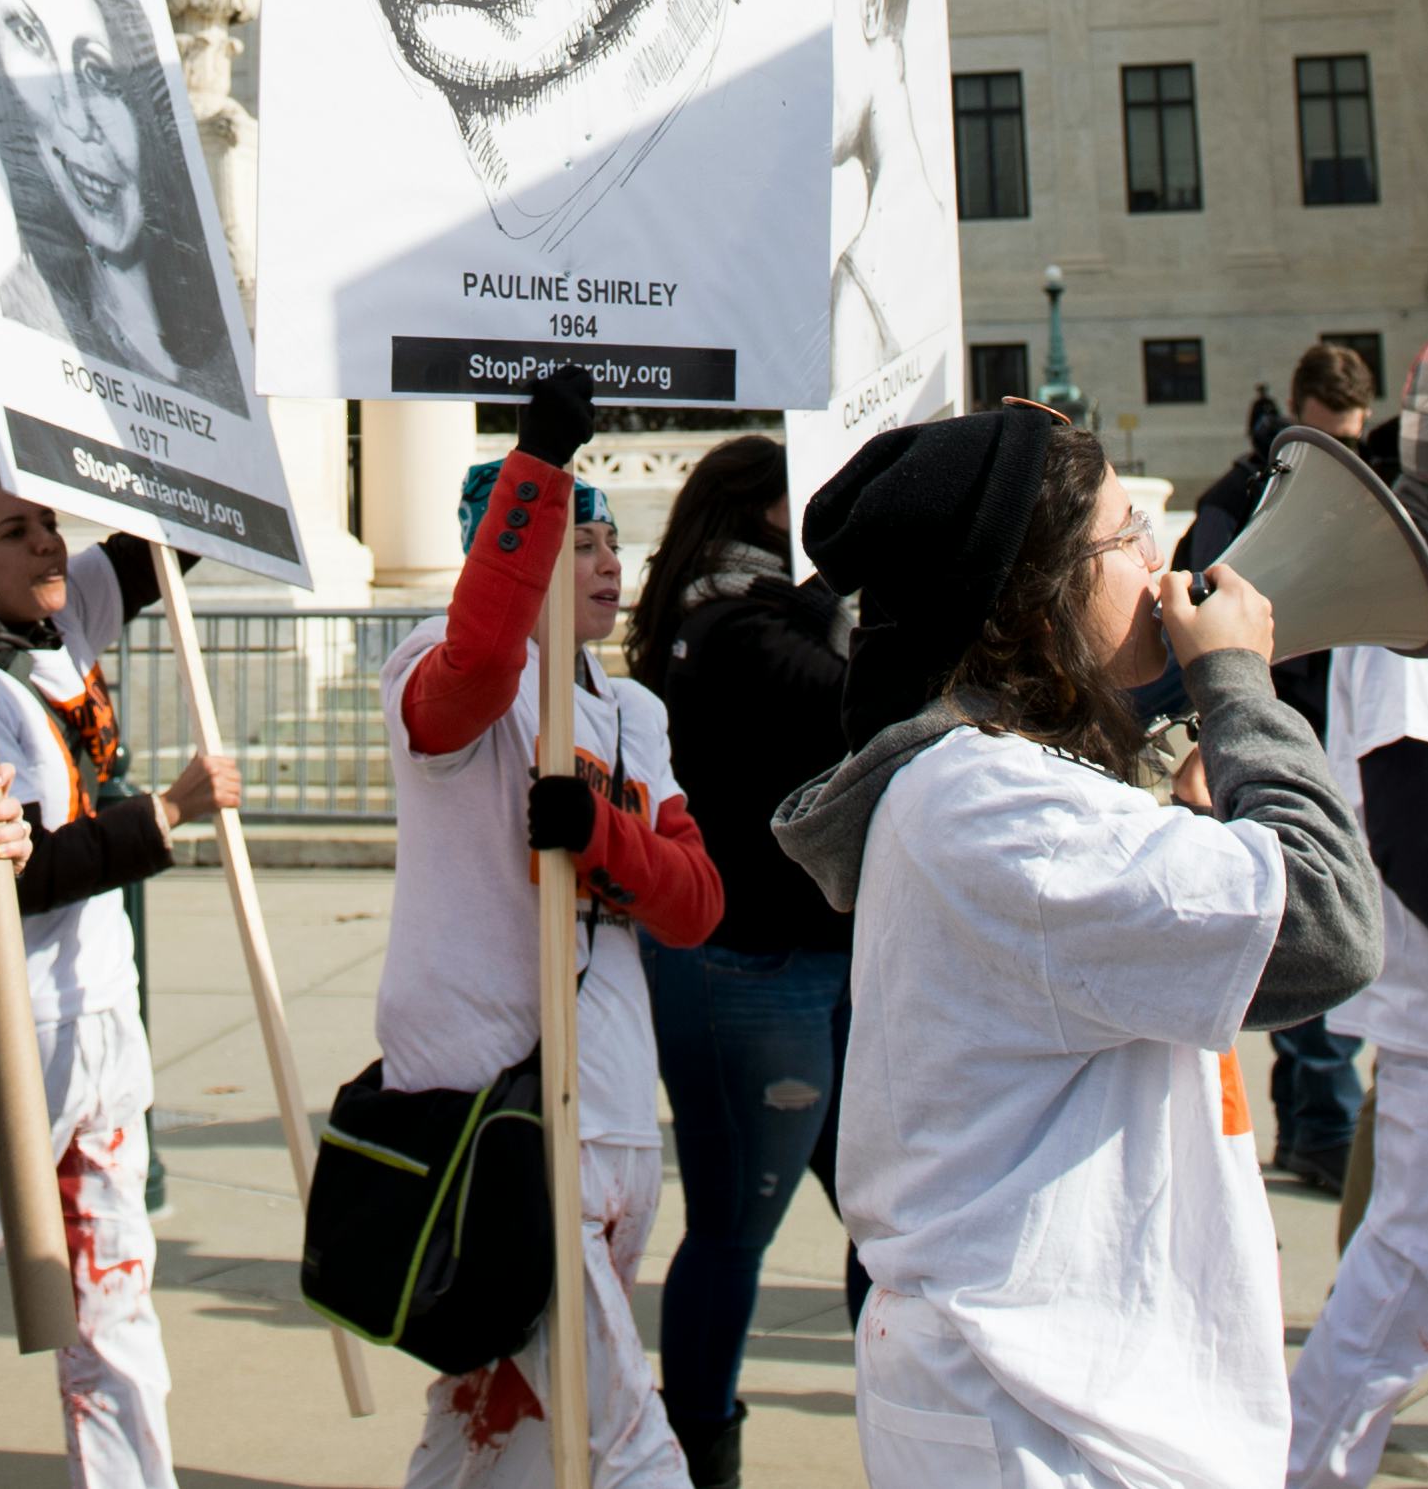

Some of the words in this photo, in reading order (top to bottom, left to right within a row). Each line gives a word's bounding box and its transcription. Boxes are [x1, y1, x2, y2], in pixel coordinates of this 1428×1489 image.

[462, 272, 570, 303] PAULINE
[576, 278, 678, 308] SHIRLEY
[549, 313, 598, 339] 1964
[61, 359, 128, 409] ROSIE
[132, 382, 217, 442] JIMENEZ
[843, 383, 883, 430] CLARA
[129, 422, 170, 459] 1977
[72, 446, 246, 537] StopPatriarchy.org
